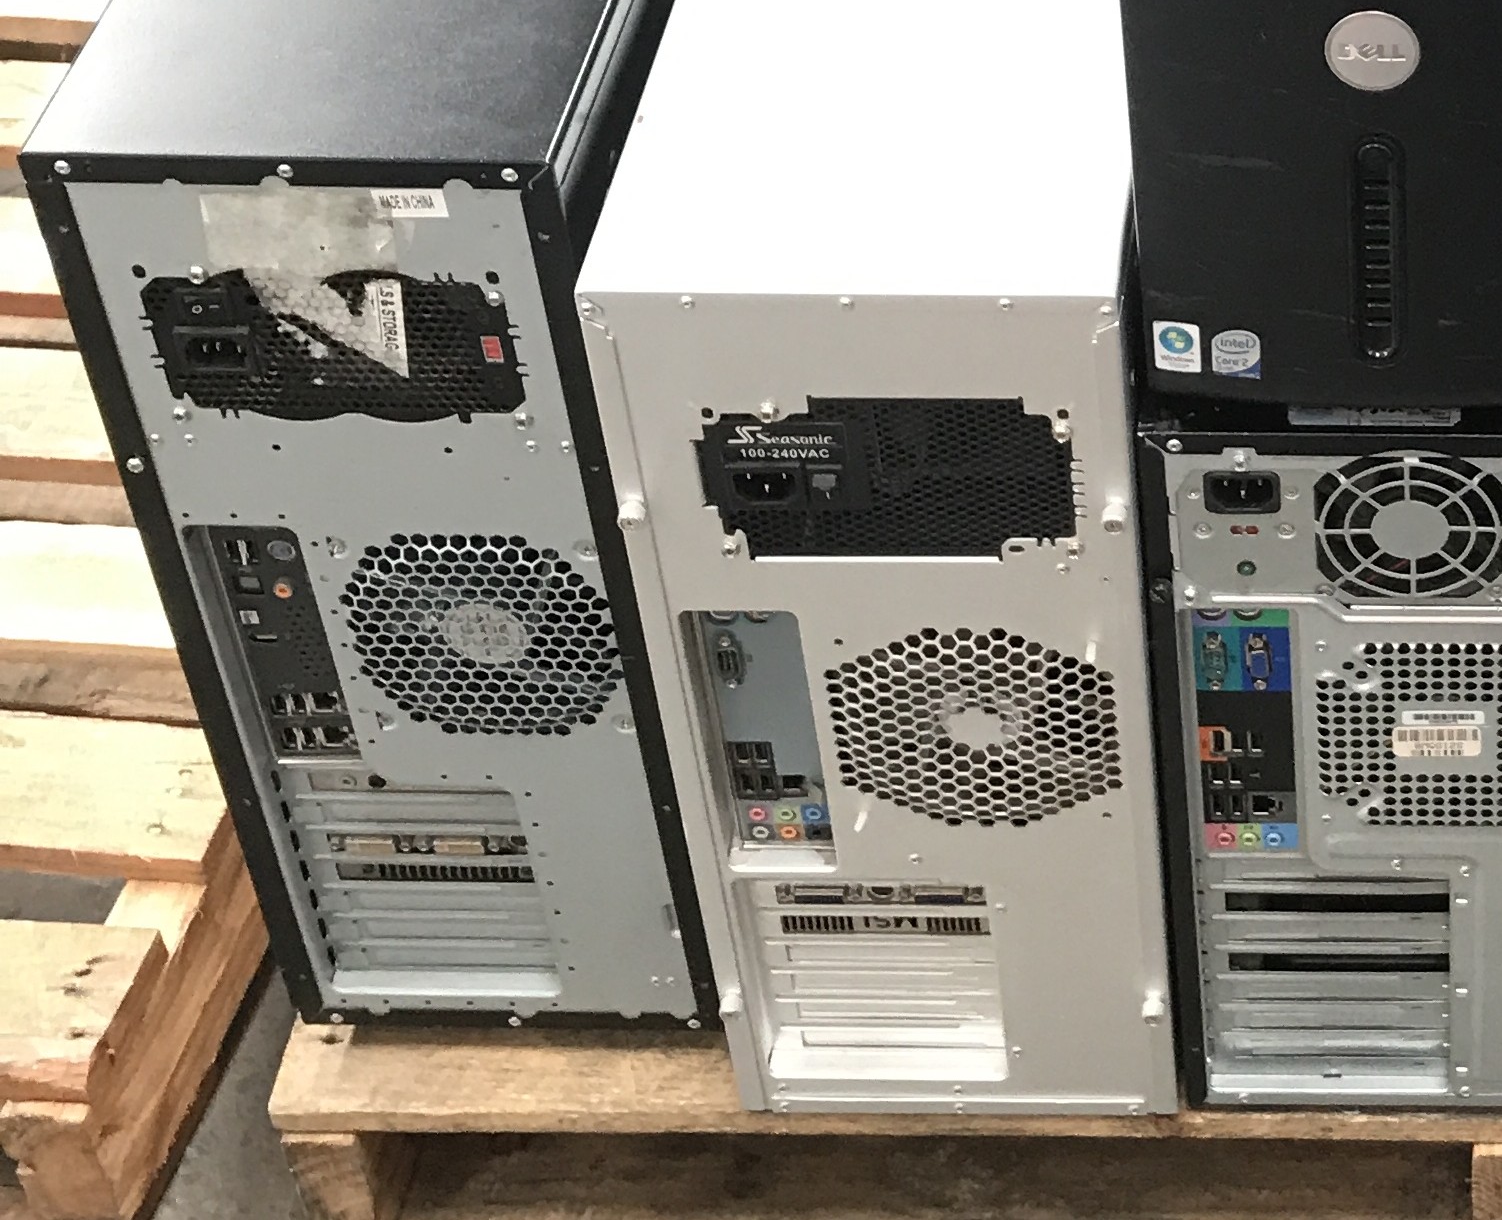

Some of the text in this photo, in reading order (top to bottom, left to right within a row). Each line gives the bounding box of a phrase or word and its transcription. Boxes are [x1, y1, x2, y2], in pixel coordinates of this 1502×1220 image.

[1337, 43, 1406, 62] DELL
[379, 194, 436, 210] MADE IN CHINA
[1220, 338, 1250, 349] intel
[1215, 355, 1239, 366] Core
[755, 432, 837, 445] Seasonic
[740, 448, 830, 459] 100-240VAC
[863, 916, 919, 929] MSI
